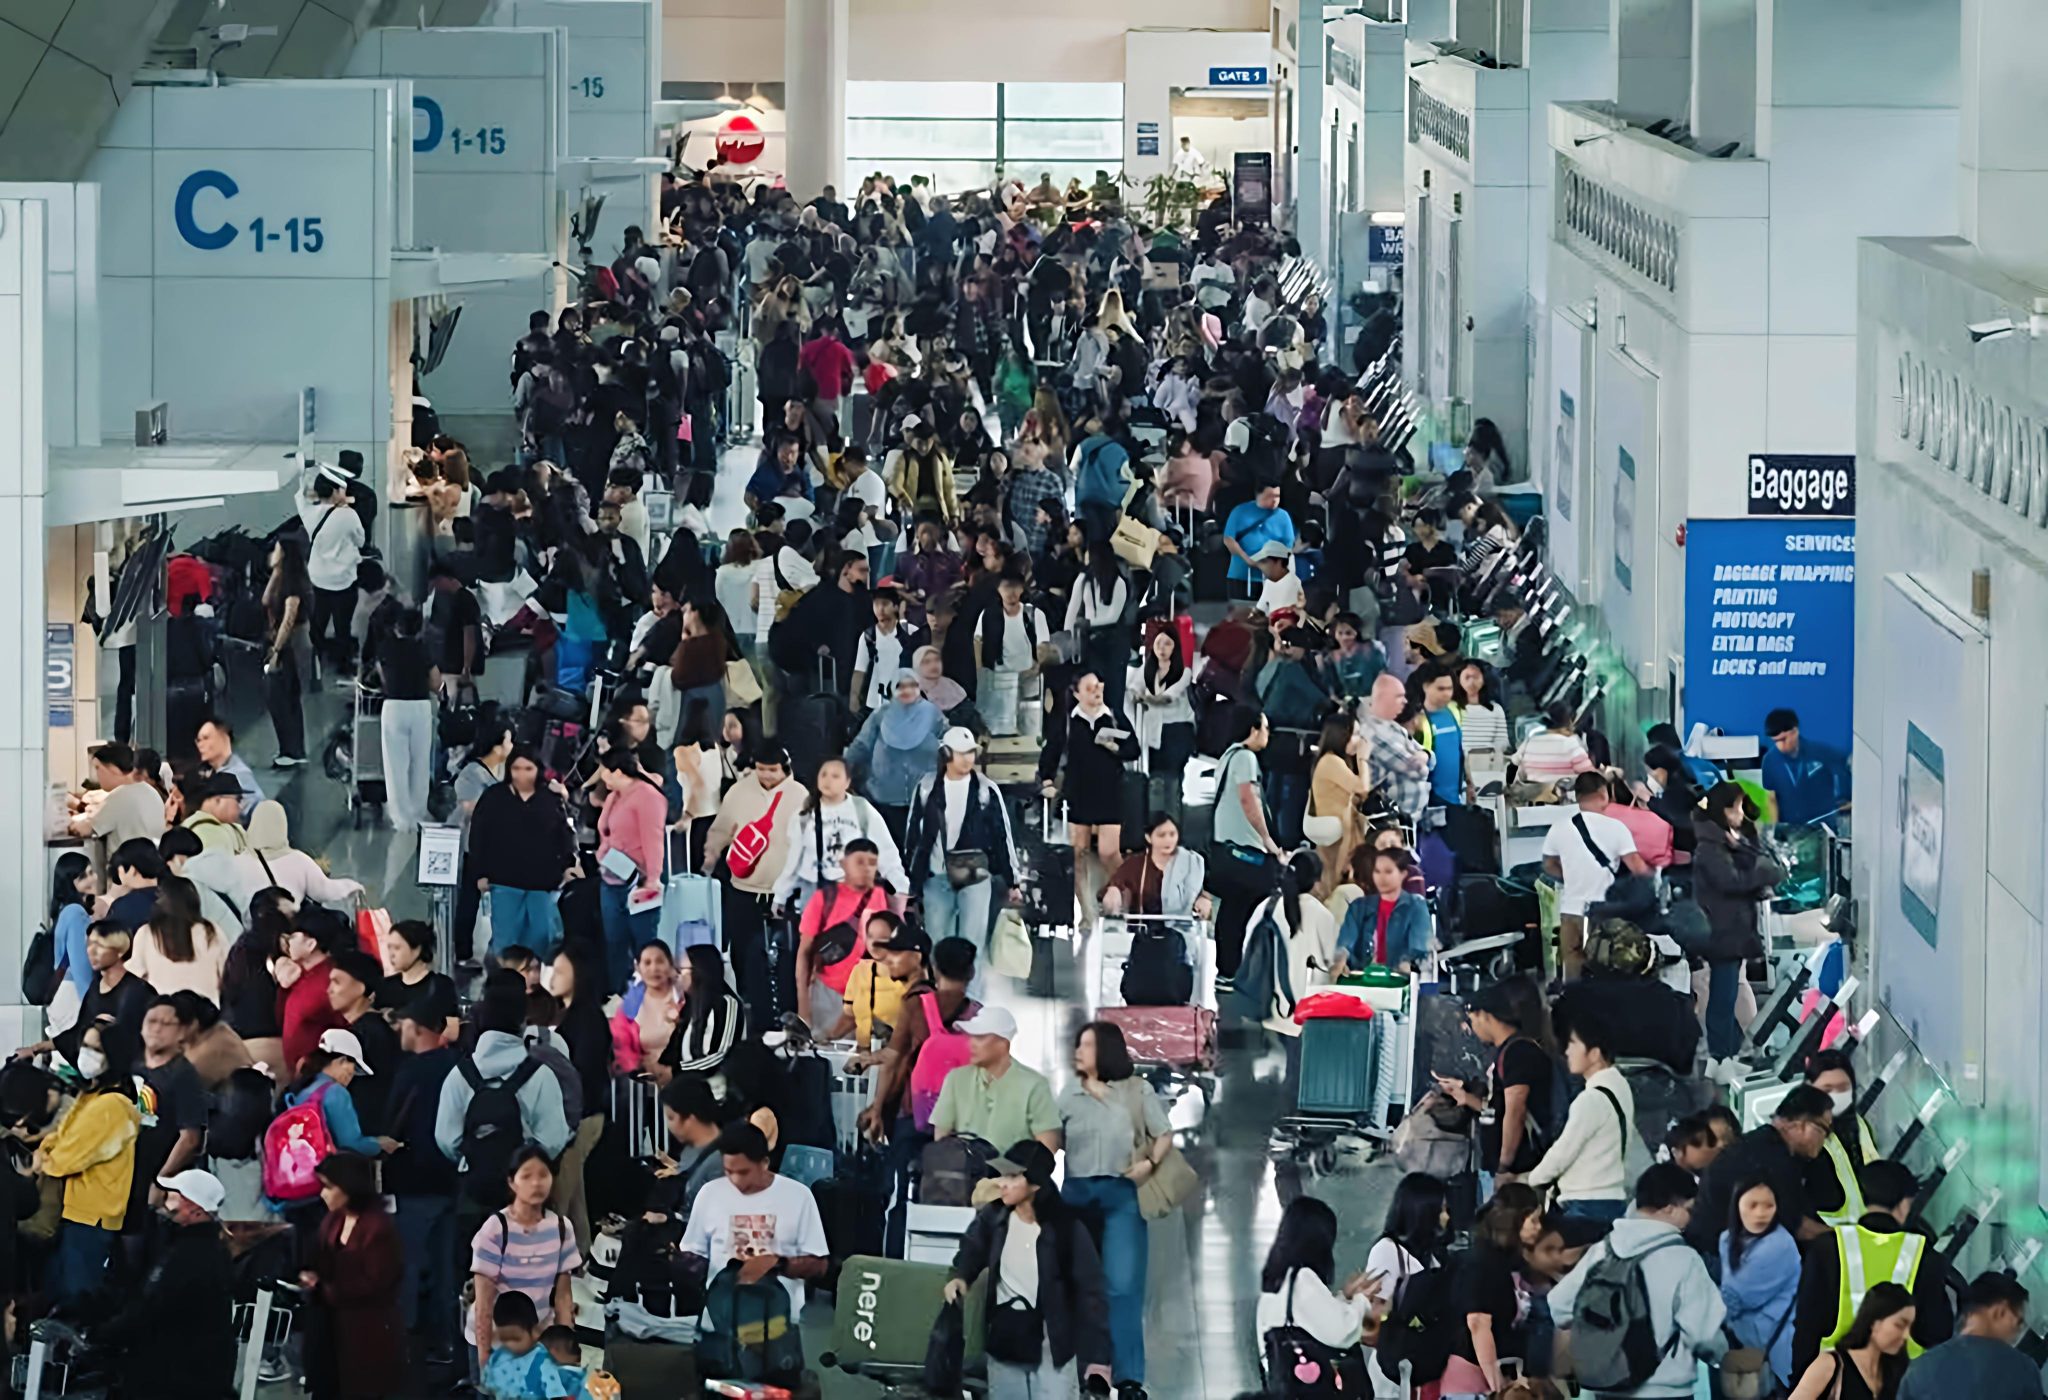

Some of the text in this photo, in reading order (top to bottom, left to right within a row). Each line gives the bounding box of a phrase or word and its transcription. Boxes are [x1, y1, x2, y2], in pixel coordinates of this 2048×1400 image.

[1218, 71, 1250, 82] GATE
[412, 96, 506, 155] D 1-15
[174, 169, 324, 253] C 1-15
[1750, 458, 1848, 510] Baggage
[1713, 564, 1855, 582] BAGGAGE WRAPPING
[1713, 587, 1778, 605] PRINTING
[1712, 611, 1796, 629] PHOTOCOPY
[1711, 635, 1755, 652] EXTRA
[1712, 658, 1757, 675] LOCKS
[1758, 658, 1788, 675] and
